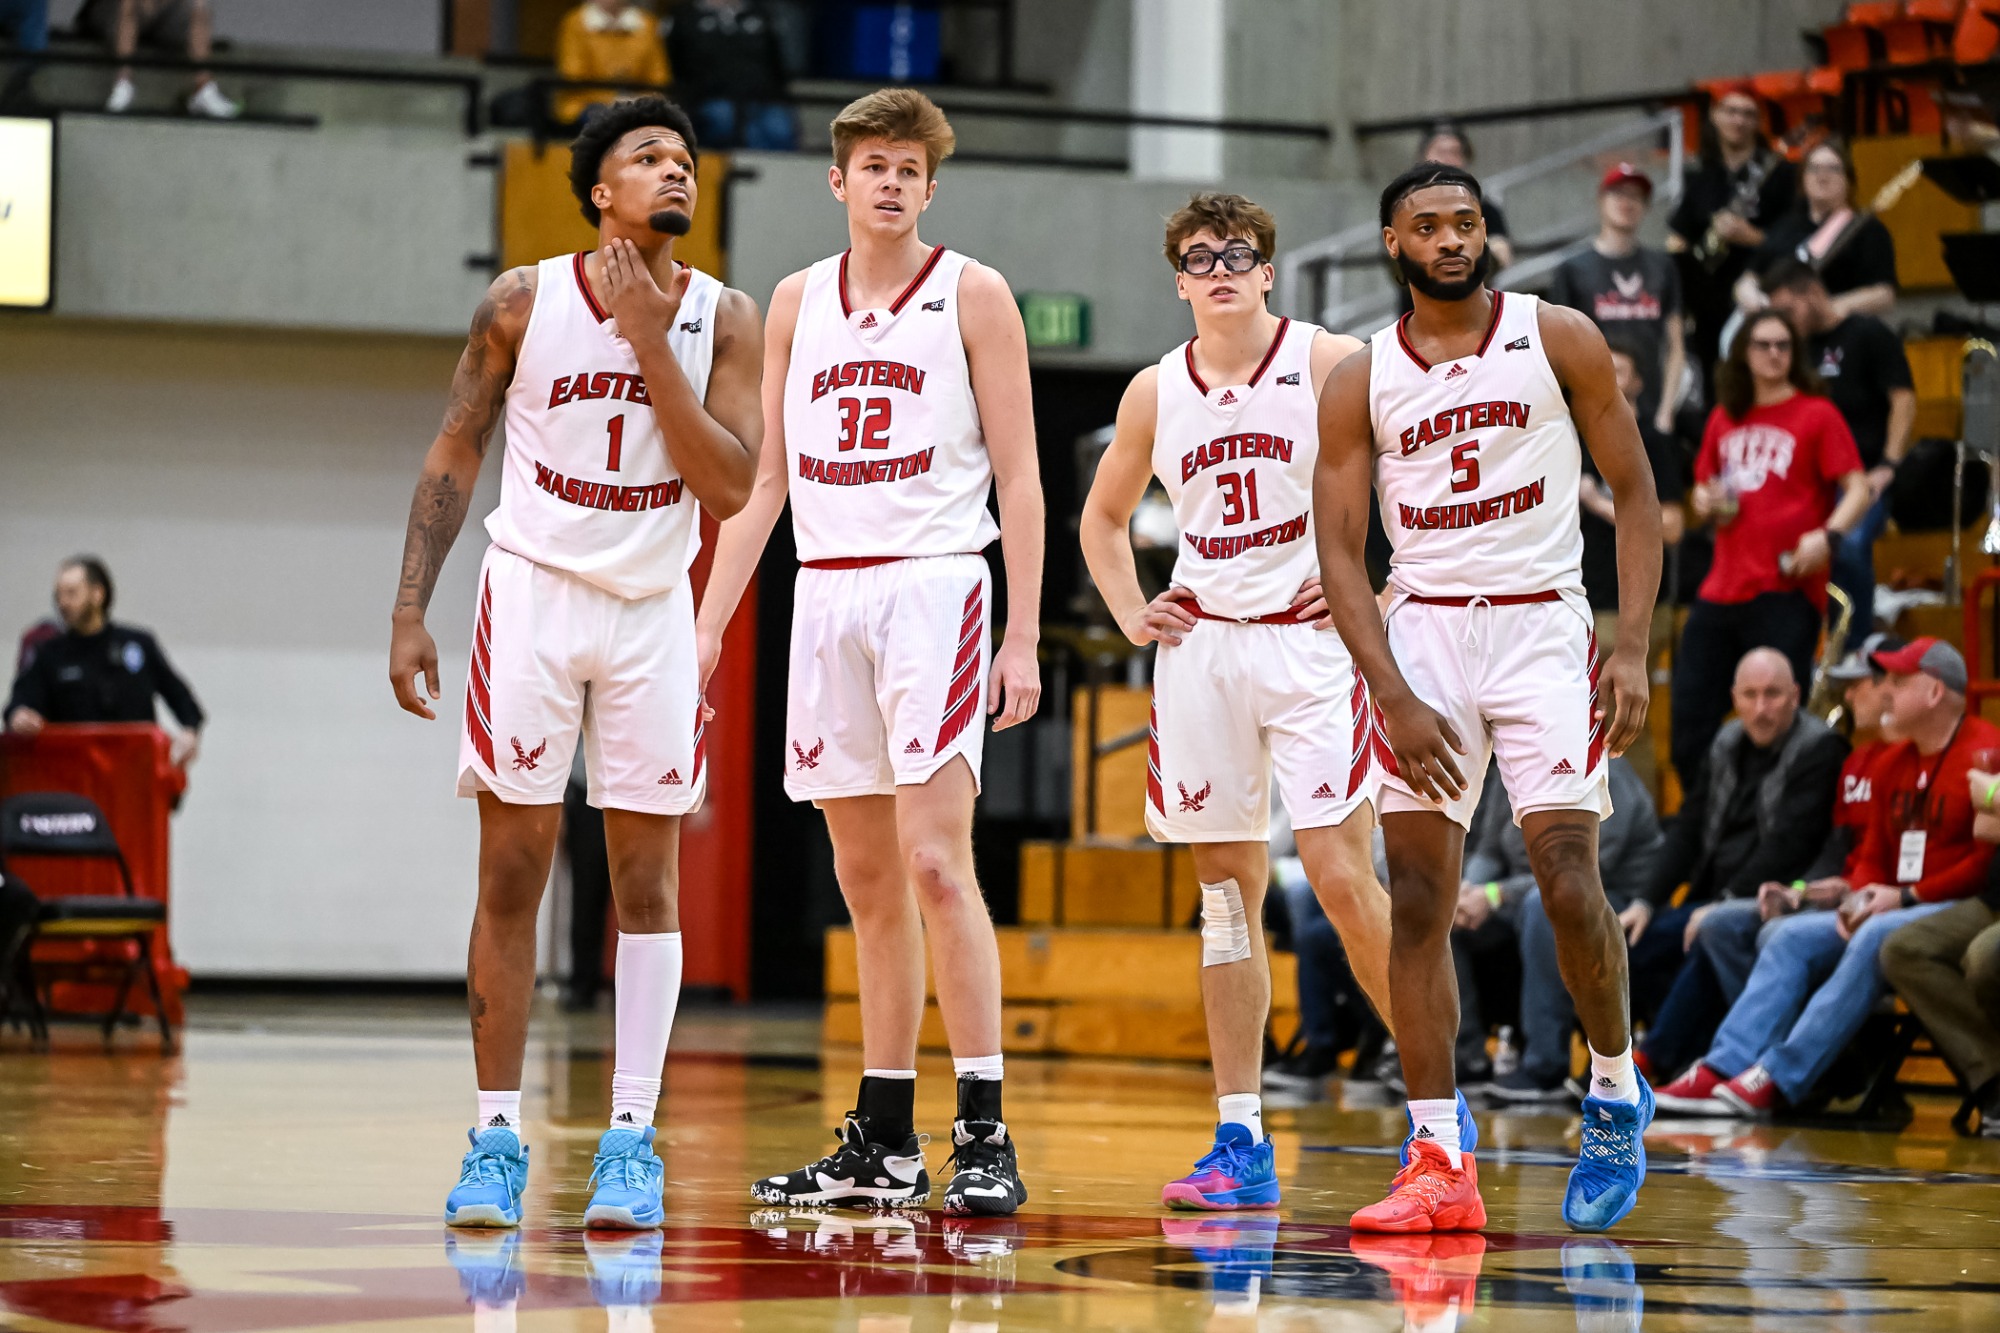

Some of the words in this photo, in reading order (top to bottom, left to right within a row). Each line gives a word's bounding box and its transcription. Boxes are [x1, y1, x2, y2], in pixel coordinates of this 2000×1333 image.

[548, 372, 652, 410] EASTE
[811, 360, 926, 403] EASTERN
[606, 414, 624, 471] 1
[838, 397, 891, 451] 32
[1400, 400, 1531, 457] EASTERN
[534, 460, 684, 511] WASHINGTON
[799, 446, 935, 485] WASHINGTON
[1181, 432, 1293, 485] EASTERN
[1450, 439, 1480, 493] 5
[1216, 468, 1260, 526] 31
[1397, 476, 1545, 530] WASHINGTON
